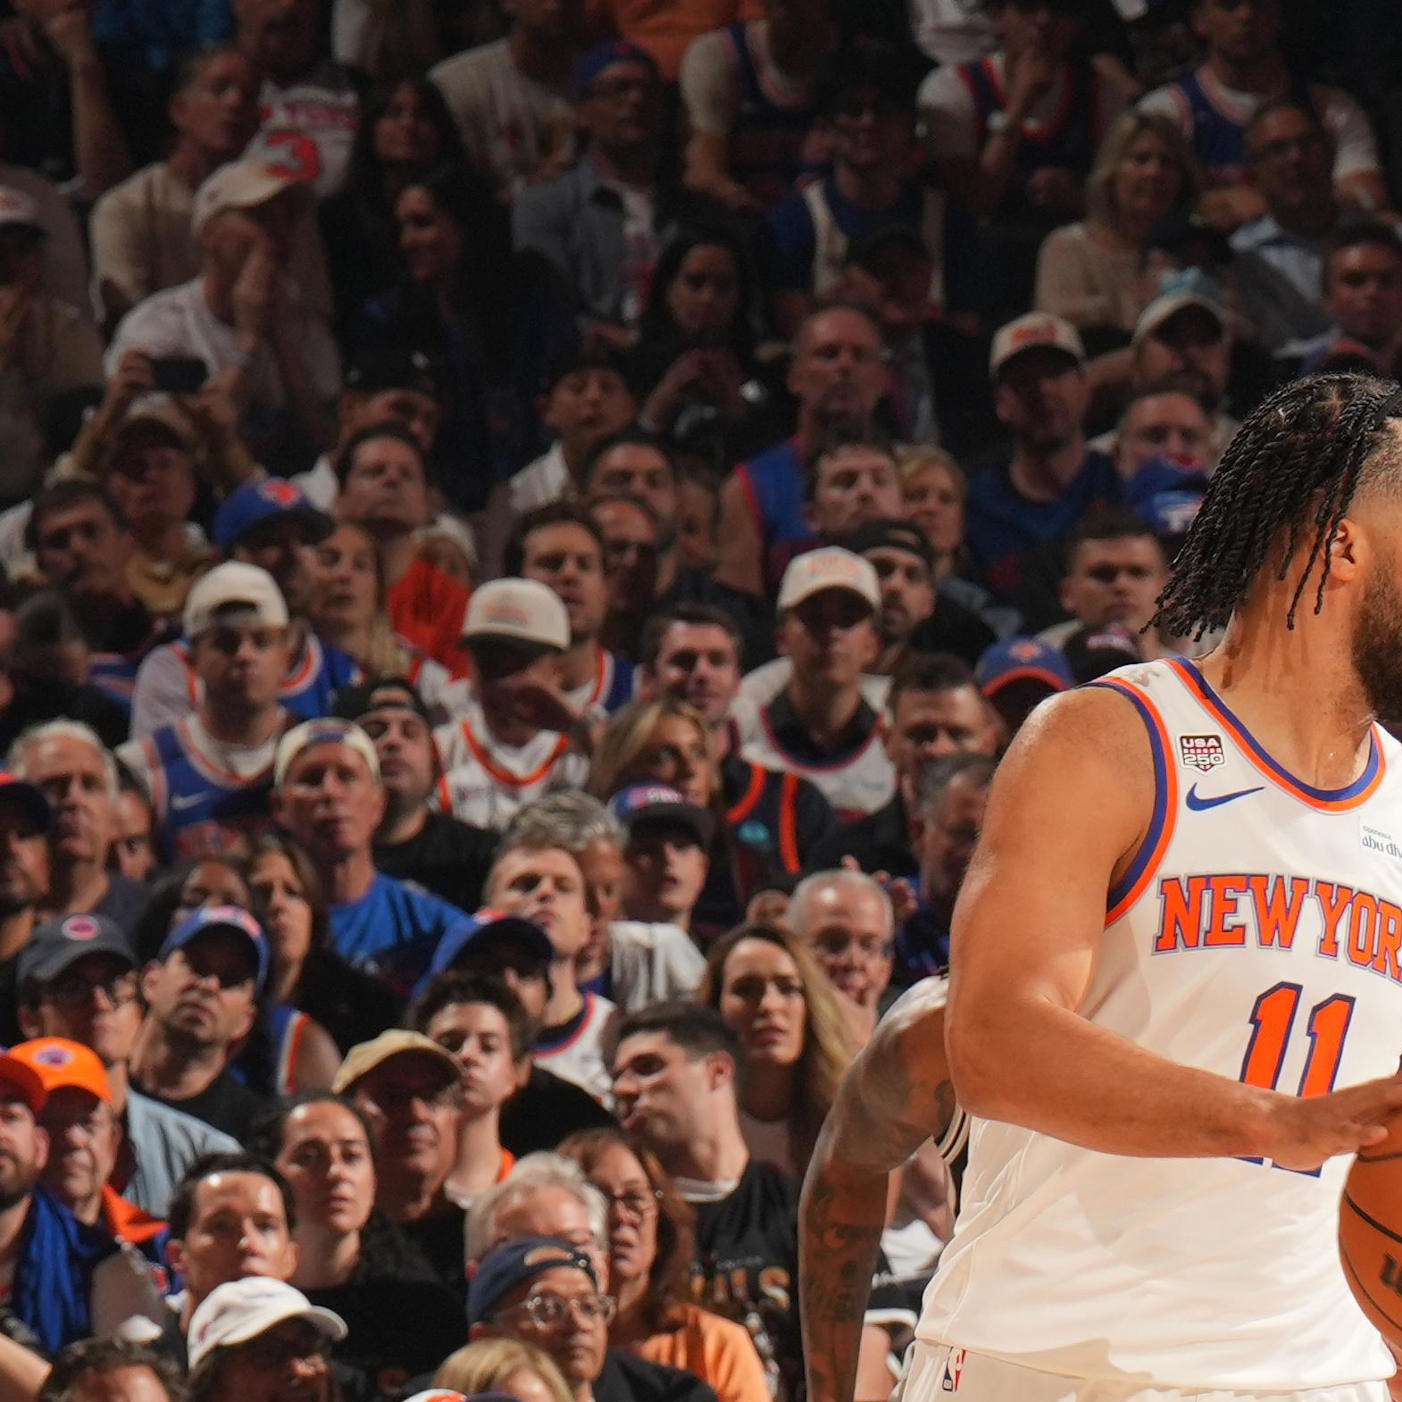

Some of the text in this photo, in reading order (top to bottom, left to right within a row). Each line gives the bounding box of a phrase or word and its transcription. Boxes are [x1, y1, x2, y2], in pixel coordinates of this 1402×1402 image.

[1182, 737, 1220, 749] USA
[1183, 753, 1224, 766] 250
[1362, 837, 1385, 854] abu
[1151, 872, 1310, 956] NEW
[1236, 981, 1356, 1178] 11
